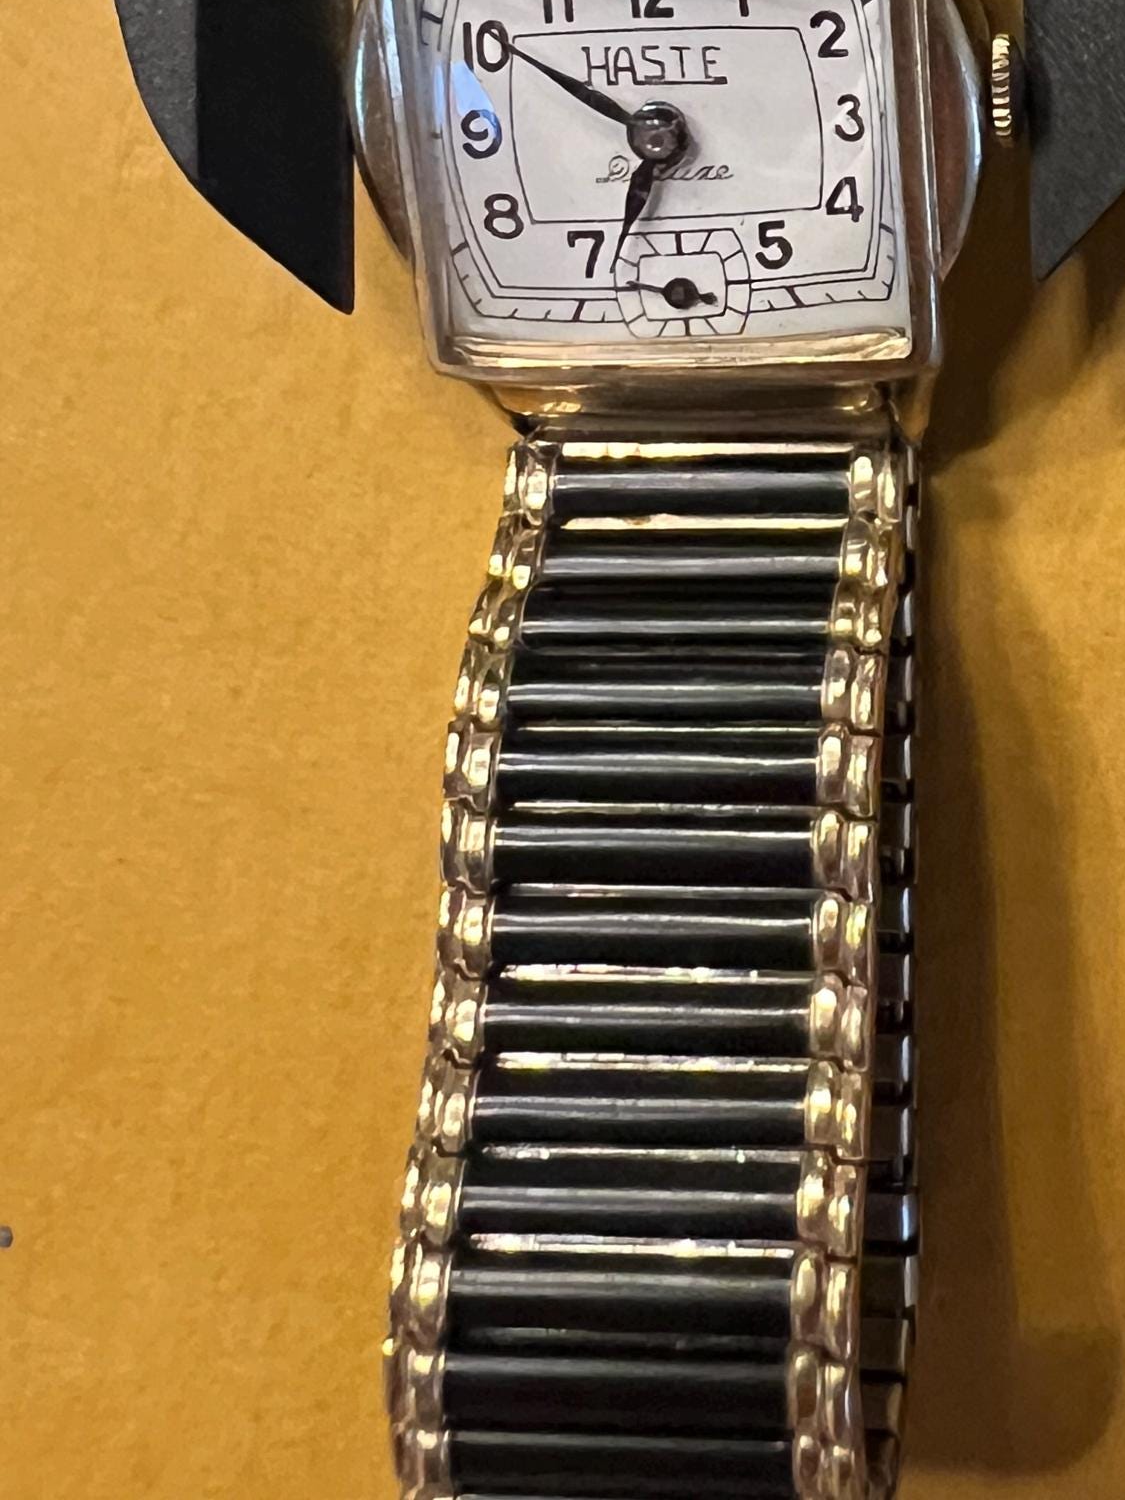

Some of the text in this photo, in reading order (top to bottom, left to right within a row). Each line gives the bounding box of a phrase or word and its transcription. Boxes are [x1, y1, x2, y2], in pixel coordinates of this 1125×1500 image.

[462, 19, 510, 73] 10
[809, 10, 849, 58] 2
[581, 45, 728, 86] HASTE
[461, 109, 502, 159] 9
[833, 94, 864, 141] 3
[596, 154, 734, 184] Duxe
[483, 193, 524, 240] 8
[826, 176, 864, 223] 4
[566, 230, 606, 279] 7
[755, 220, 794, 271] 5
